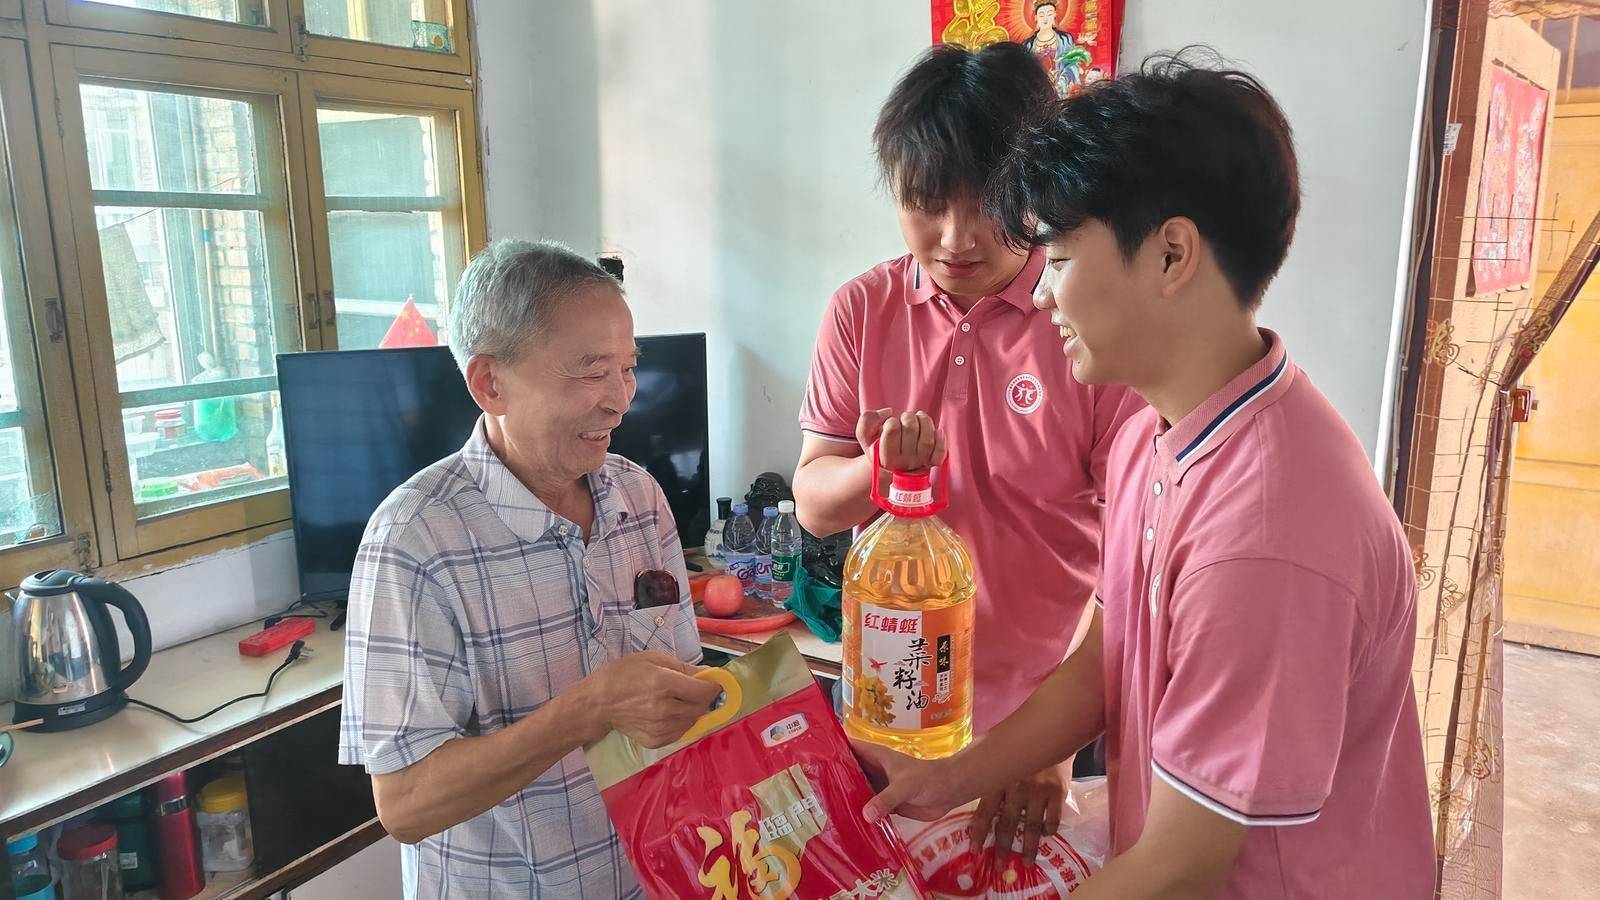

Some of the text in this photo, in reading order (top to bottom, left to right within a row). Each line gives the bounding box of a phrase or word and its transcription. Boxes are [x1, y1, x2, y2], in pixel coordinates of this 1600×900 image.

[864, 613, 918, 634] 红蜻蜓
[893, 638, 932, 711] 菜籽油
